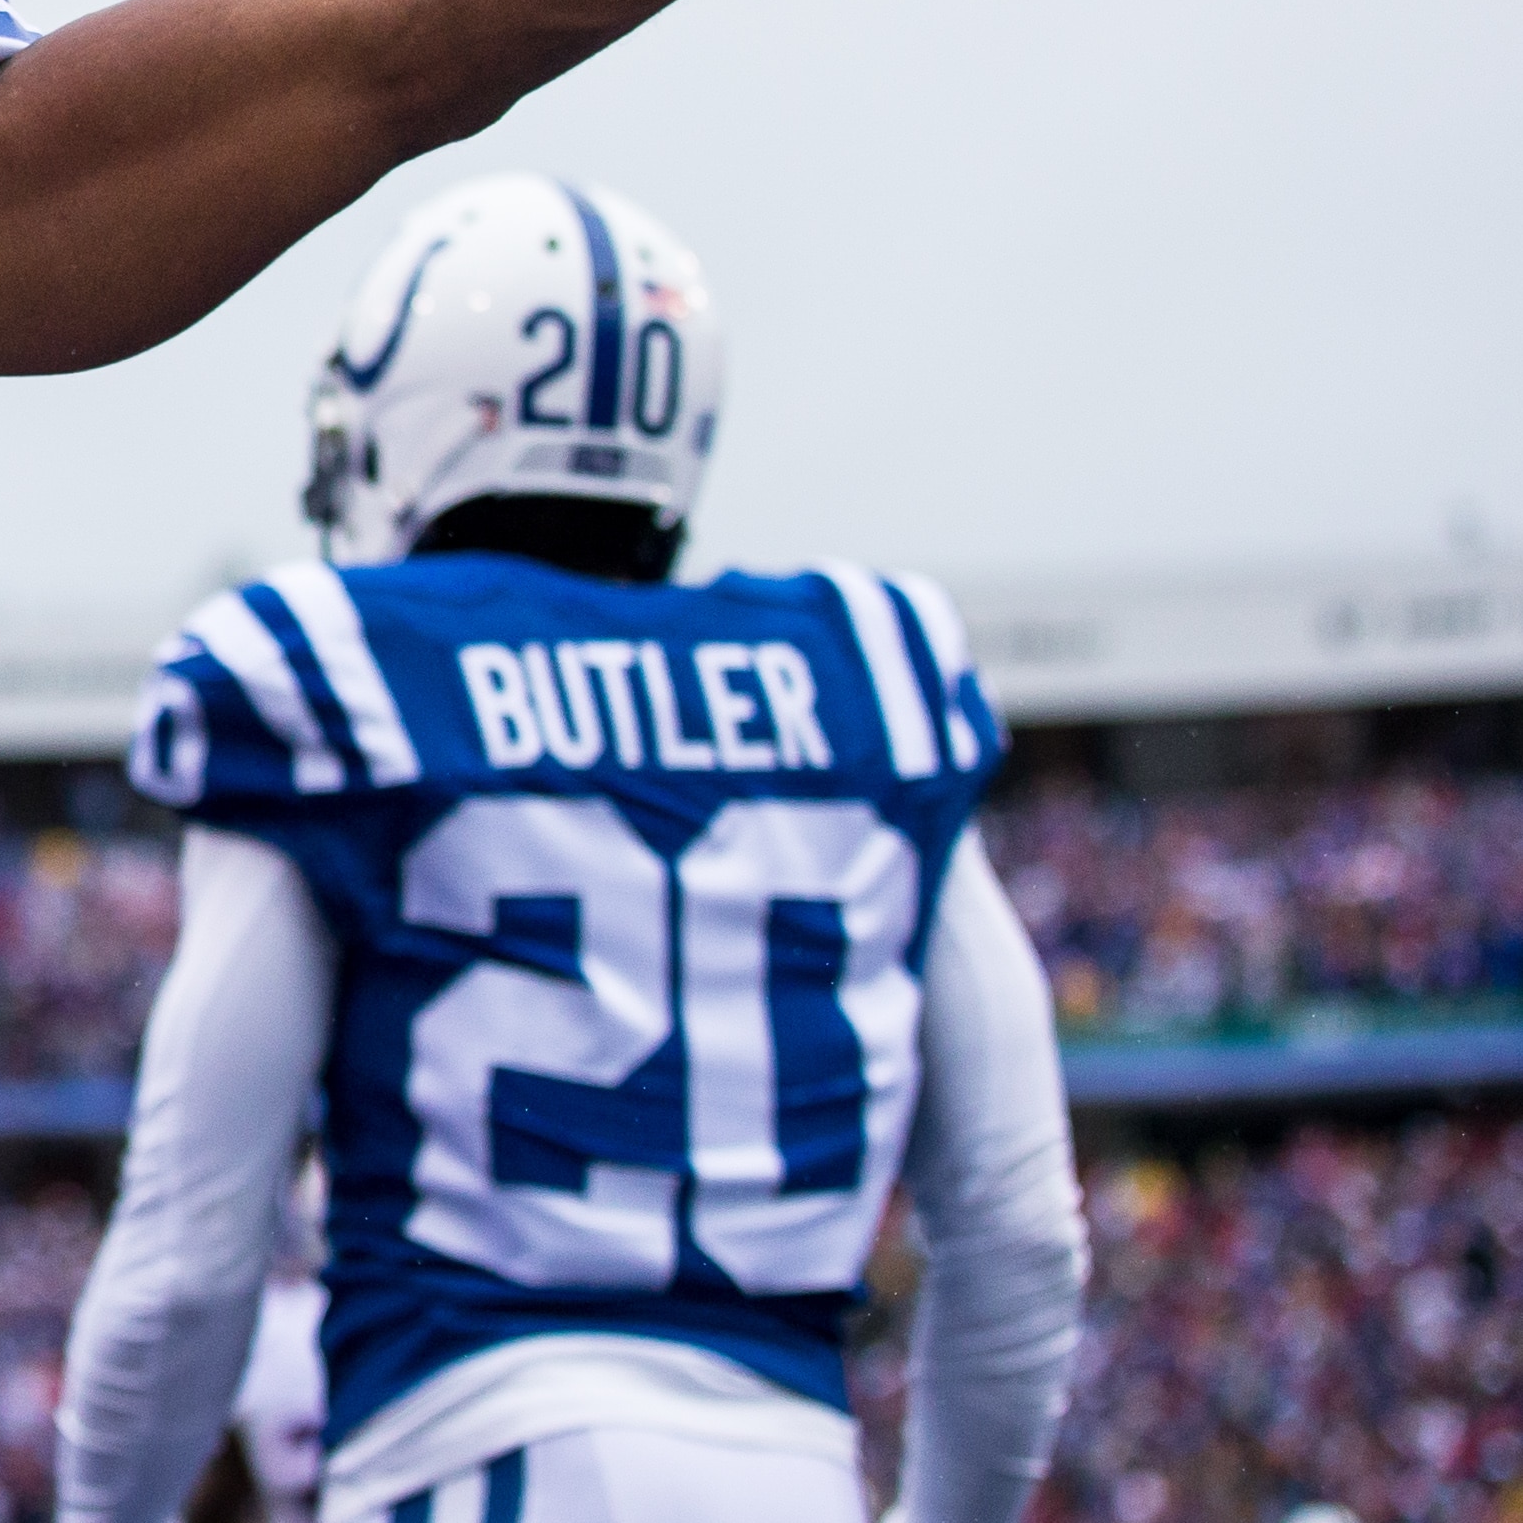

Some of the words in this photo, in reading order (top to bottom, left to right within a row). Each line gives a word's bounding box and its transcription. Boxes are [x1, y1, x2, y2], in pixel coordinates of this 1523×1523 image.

[518, 307, 684, 439] 20
[458, 637, 835, 772] BUTLER
[397, 792, 923, 1296] 20
